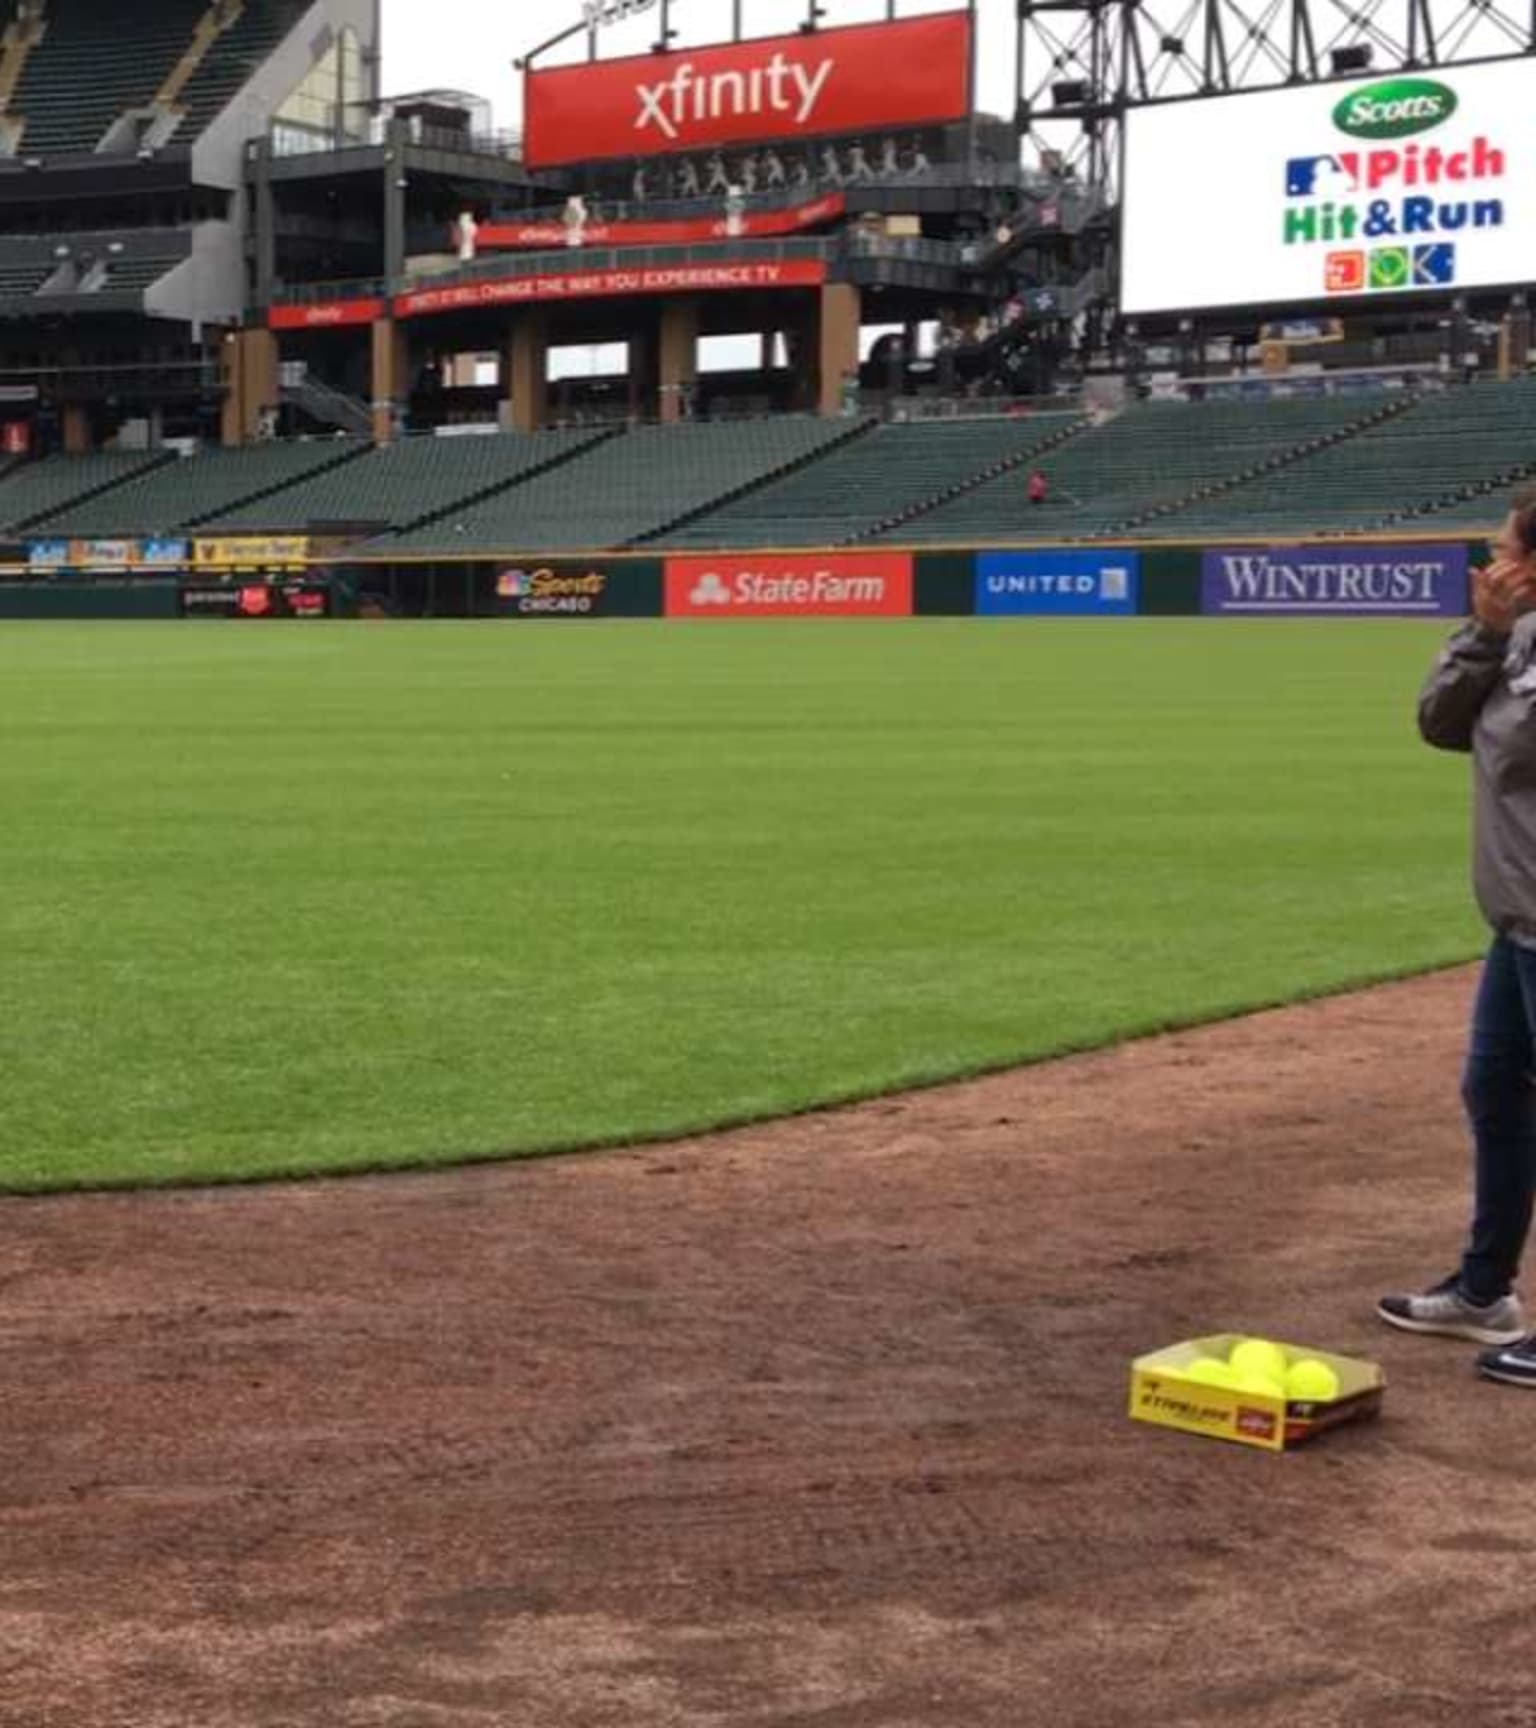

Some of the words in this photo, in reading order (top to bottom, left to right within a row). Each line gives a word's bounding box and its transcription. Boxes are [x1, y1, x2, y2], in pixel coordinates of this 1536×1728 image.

[634, 53, 834, 138] xfinity
[1347, 94, 1443, 126] Scotts
[1368, 136, 1504, 189] Pitch
[480, 281, 532, 299] CHANGE
[537, 278, 564, 293] THE
[569, 276, 601, 291] WAY
[606, 273, 638, 289] YOU
[643, 267, 750, 286] EXPERIENCE
[756, 265, 780, 281] TV
[531, 568, 607, 596] Sports
[987, 574, 1095, 593] UNITED
[519, 597, 591, 613] CHICAGO
